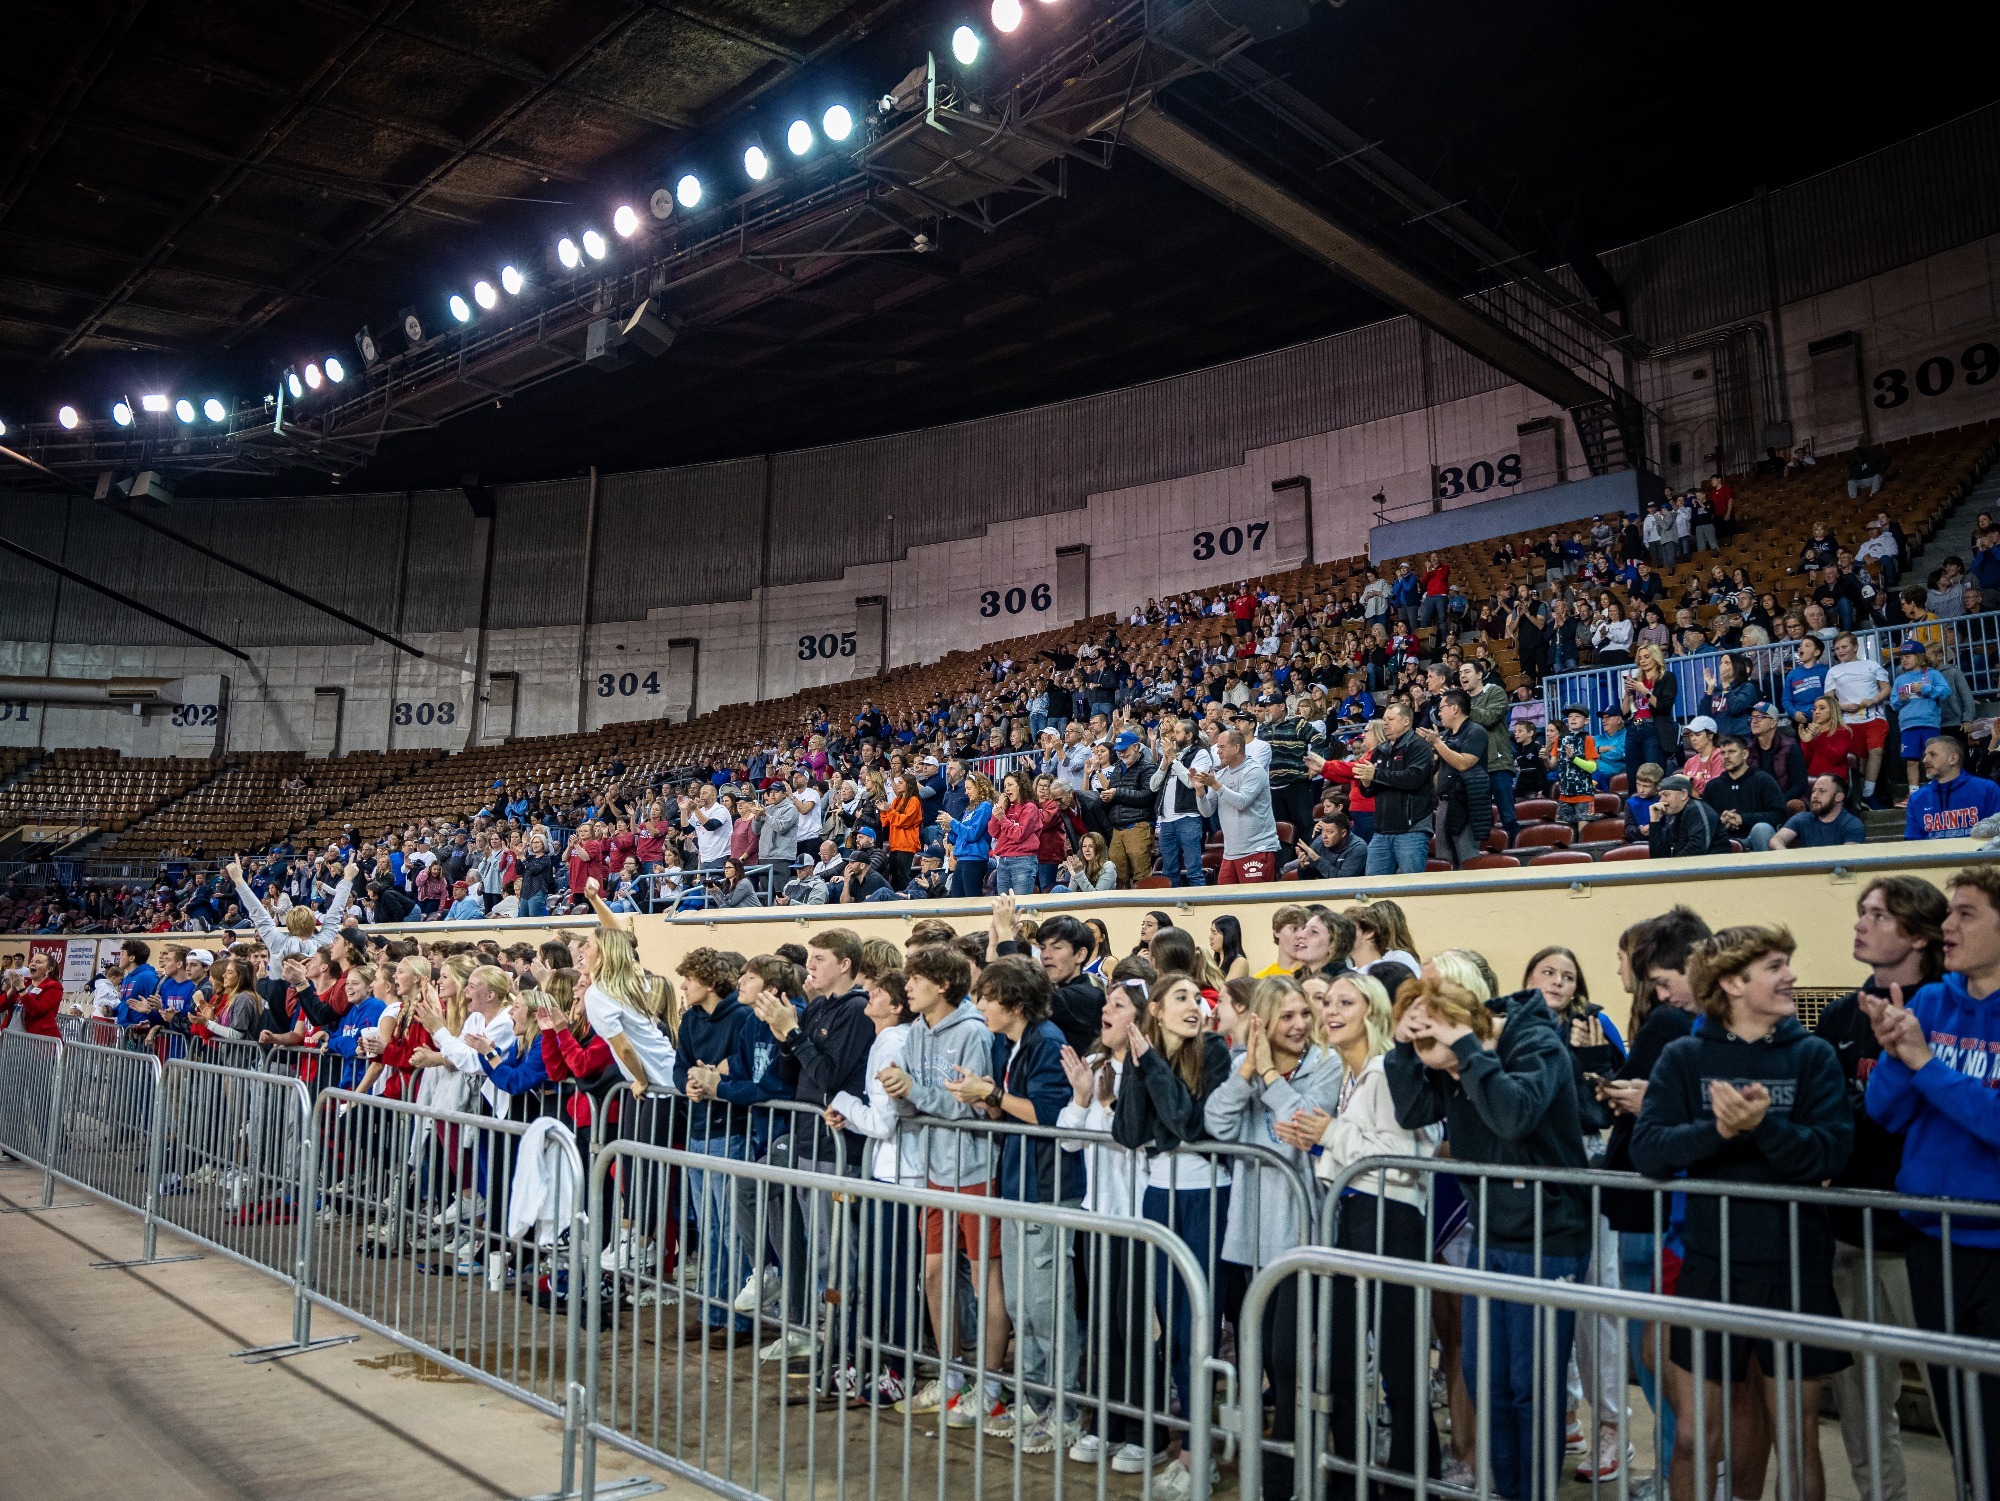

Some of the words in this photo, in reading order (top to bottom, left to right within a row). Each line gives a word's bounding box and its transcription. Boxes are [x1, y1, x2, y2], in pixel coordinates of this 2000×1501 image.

[1873, 342, 2000, 409] 309
[1439, 453, 1522, 499] 308
[1193, 521, 1270, 560] 307
[980, 583, 1052, 617] 306
[798, 631, 857, 660] 305
[597, 671, 661, 697] 304
[0, 702, 29, 721] 01
[172, 704, 218, 727] 302
[395, 701, 455, 726] 303
[1924, 806, 1979, 832] SAINTS
